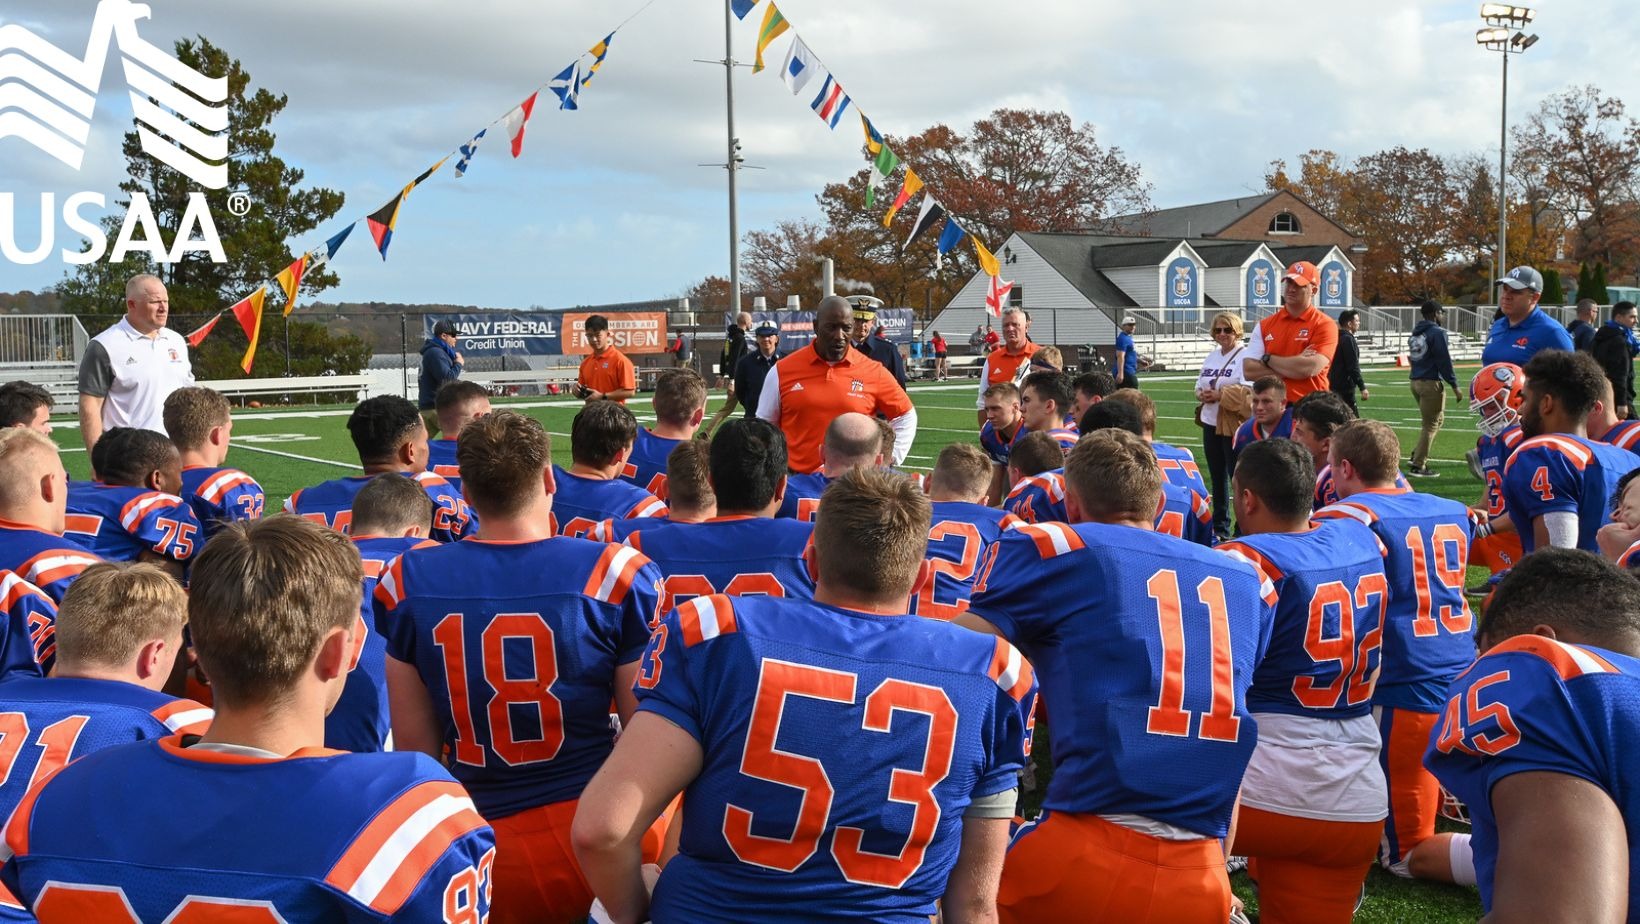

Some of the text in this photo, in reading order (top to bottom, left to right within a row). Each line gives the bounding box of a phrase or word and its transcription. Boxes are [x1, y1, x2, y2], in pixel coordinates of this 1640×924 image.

[465, 338, 525, 350] Credit Union
[493, 321, 556, 335] FEDERAL
[609, 321, 637, 329] MBERS
[433, 494, 469, 535] 25
[1530, 466, 1555, 501] 4
[152, 516, 198, 560] 75
[907, 520, 981, 622] 2
[1404, 523, 1473, 638] 19
[1146, 568, 1241, 743] 11
[1291, 572, 1388, 709] 92
[432, 612, 565, 768] 18
[1436, 669, 1521, 756] 45
[722, 657, 959, 889] 53
